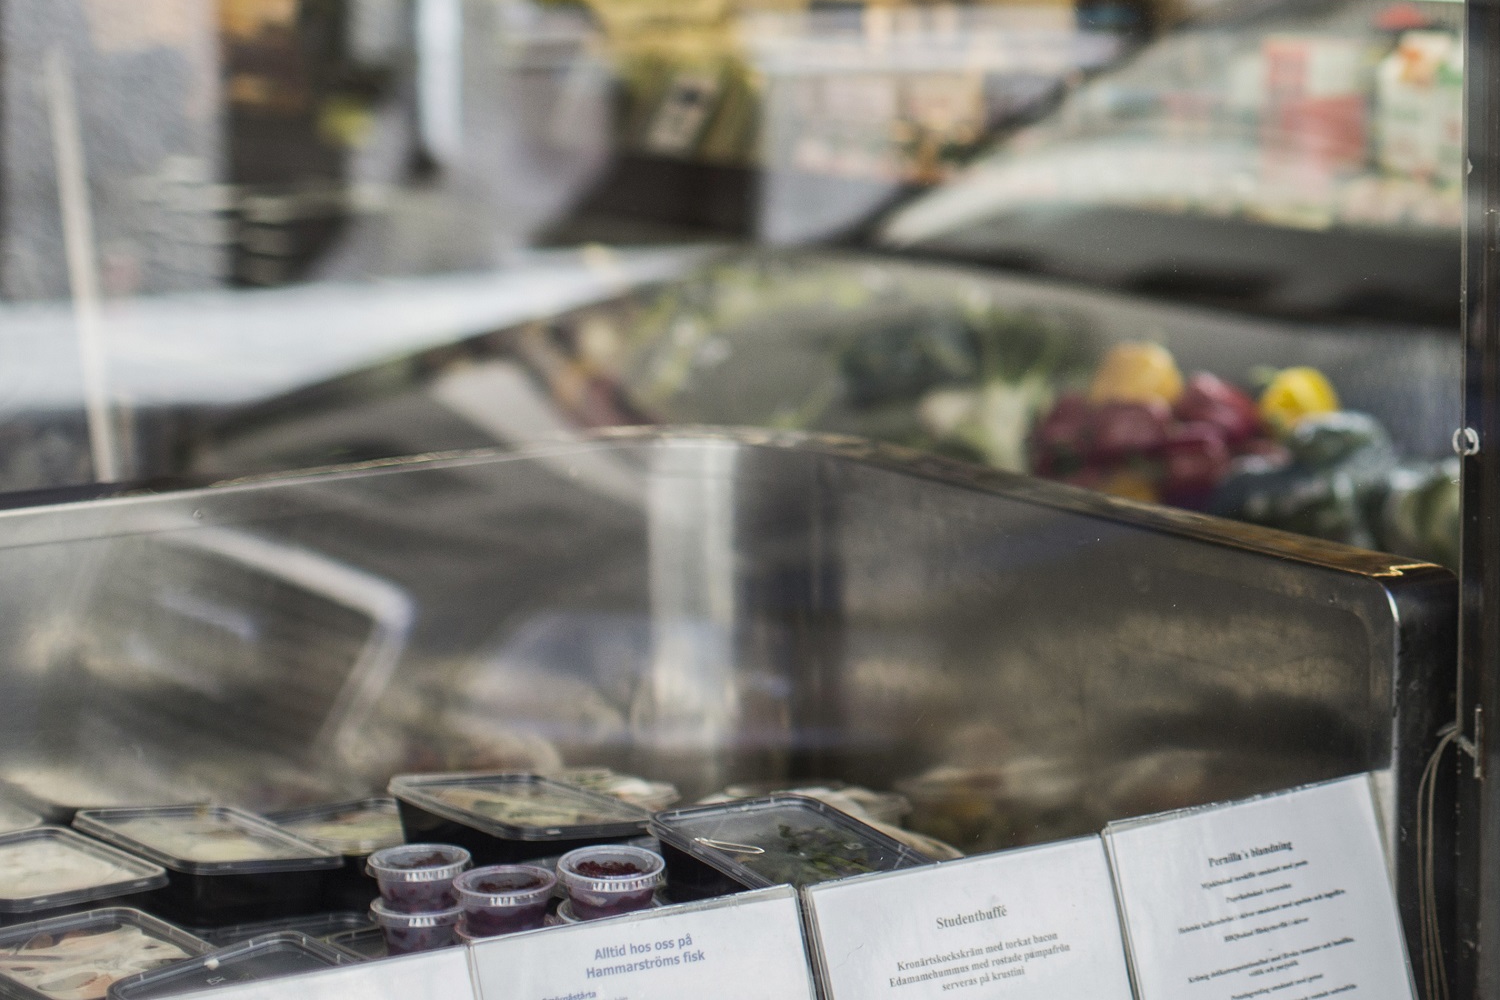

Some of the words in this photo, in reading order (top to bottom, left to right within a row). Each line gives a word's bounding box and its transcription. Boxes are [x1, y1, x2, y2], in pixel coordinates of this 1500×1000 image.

[936, 905, 1008, 930] Studentbuffé
[594, 944, 627, 960] Alltid
[630, 943, 651, 955] hos
[655, 940, 675, 951] oss
[678, 933, 693, 950] på
[897, 947, 984, 971] Kronärtskockskräm
[985, 941, 1004, 954] med
[1005, 937, 1032, 950] torkat
[1032, 933, 1058, 945] bacon
[586, 955, 680, 979] Hammarströms
[683, 949, 706, 963] fisk
[889, 965, 970, 988] Edamamehummus
[971, 959, 989, 971] med
[991, 953, 1022, 967] rostade
[1024, 943, 1071, 963] pumpafrön
[942, 977, 978, 991] serveras
[979, 972, 990, 986] på
[991, 965, 1026, 981] krustini
